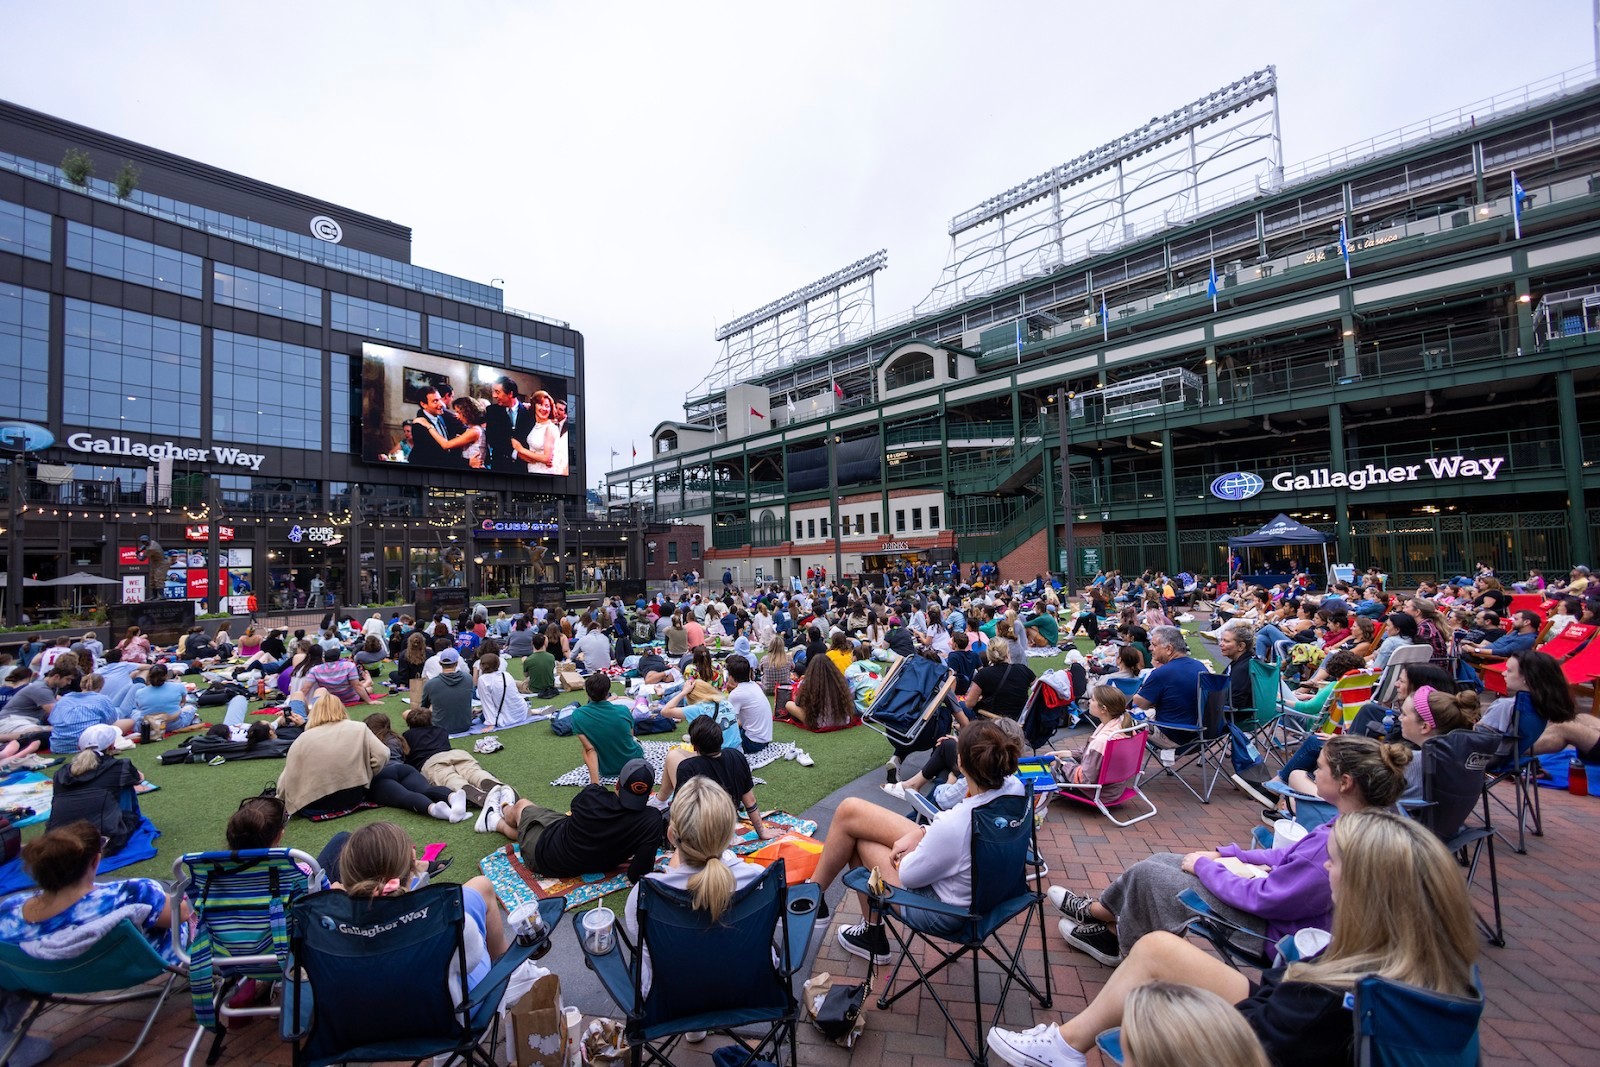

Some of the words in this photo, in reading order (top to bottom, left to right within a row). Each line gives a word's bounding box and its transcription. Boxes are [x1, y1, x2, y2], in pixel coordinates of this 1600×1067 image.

[67, 432, 210, 462] Gallagher
[211, 446, 265, 471] Way
[1272, 464, 1420, 491] Gallagher
[1425, 455, 1505, 480] Way
[495, 522, 529, 530] CUBS
[338, 921, 399, 938] Gallagher
[399, 906, 430, 925] Way
